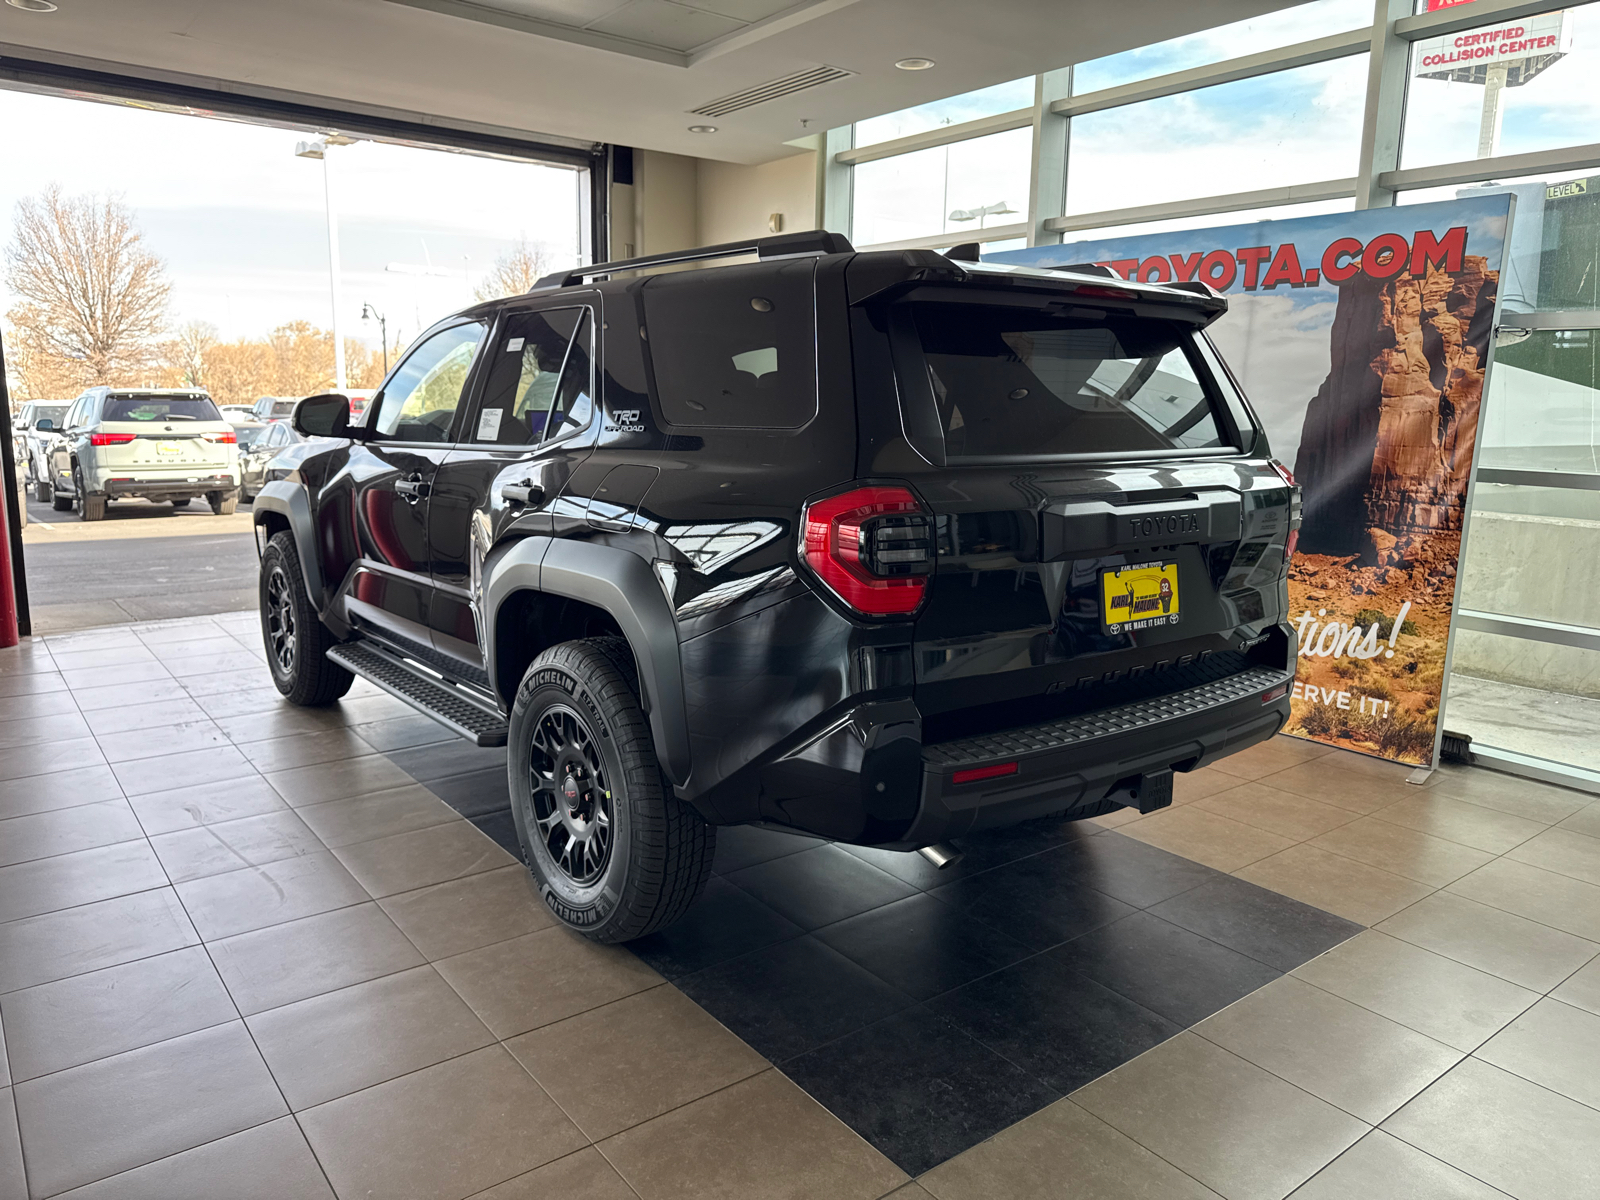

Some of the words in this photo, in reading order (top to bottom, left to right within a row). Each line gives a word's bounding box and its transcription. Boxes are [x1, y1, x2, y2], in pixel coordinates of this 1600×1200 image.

[1454, 26, 1524, 48] CERTIFIED
[1422, 45, 1494, 67] COLLISION
[1499, 35, 1556, 54] CENTER
[1548, 185, 1575, 199] LEVEL
[1093, 225, 1468, 294] TOYOTA.COM
[612, 409, 641, 425] TRD
[1130, 513, 1200, 539] TOYOTA
[1161, 582, 1170, 593] 32
[1124, 622, 1133, 632] WE
[1133, 620, 1148, 630] MAKE
[1148, 619, 1154, 628] IT
[1290, 601, 1412, 660] tions!
[528, 671, 574, 692] MICHELIN
[582, 693, 594, 709] LTX
[1291, 681, 1352, 711] ERVE
[1360, 696, 1390, 719] IT!
[546, 894, 598, 924] MICHELIN
